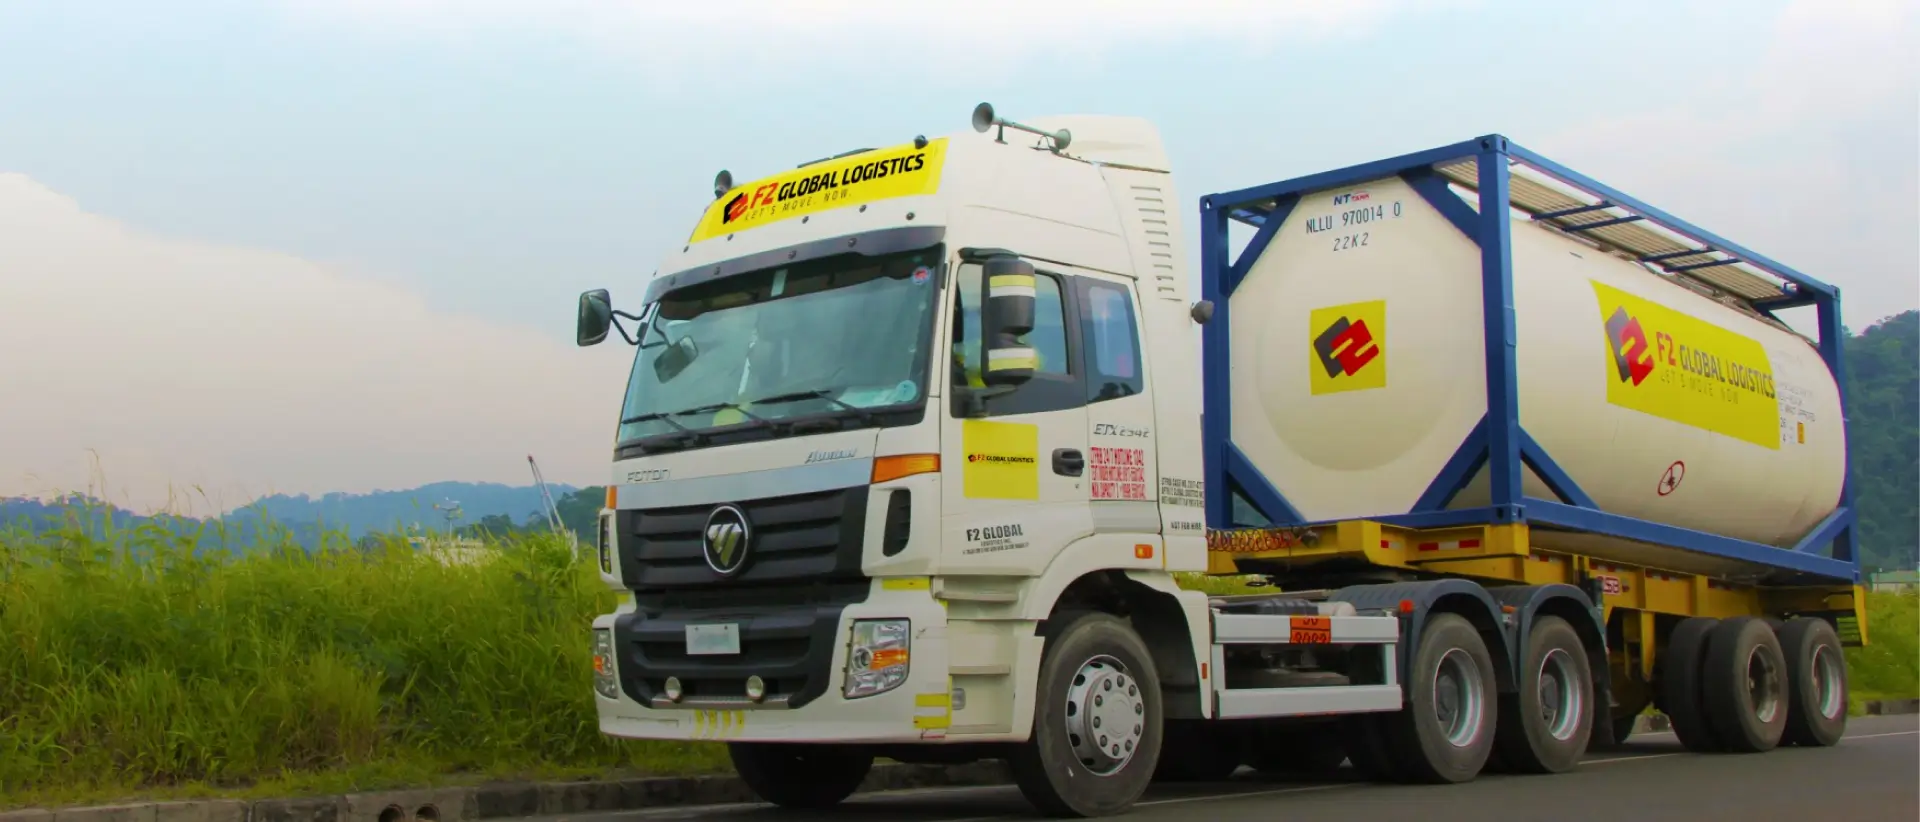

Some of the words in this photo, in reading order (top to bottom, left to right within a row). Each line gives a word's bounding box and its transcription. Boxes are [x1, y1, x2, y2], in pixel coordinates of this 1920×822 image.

[750, 183, 779, 209] F2
[777, 171, 838, 201] GLOBAL
[842, 153, 925, 188] LOGISTICS
[1334, 193, 1351, 206] NT
[1306, 215, 1333, 234] NLLU
[1342, 204, 1383, 226] 970014
[1393, 201, 1401, 217] 0
[1333, 232, 1369, 252] 22K2
[1656, 331, 1677, 367] F2
[1679, 344, 1726, 383] GLOBAL
[1726, 358, 1776, 399] LOGISTICS
[966, 528, 981, 542] F2
[983, 524, 1024, 540] GLOBAL
